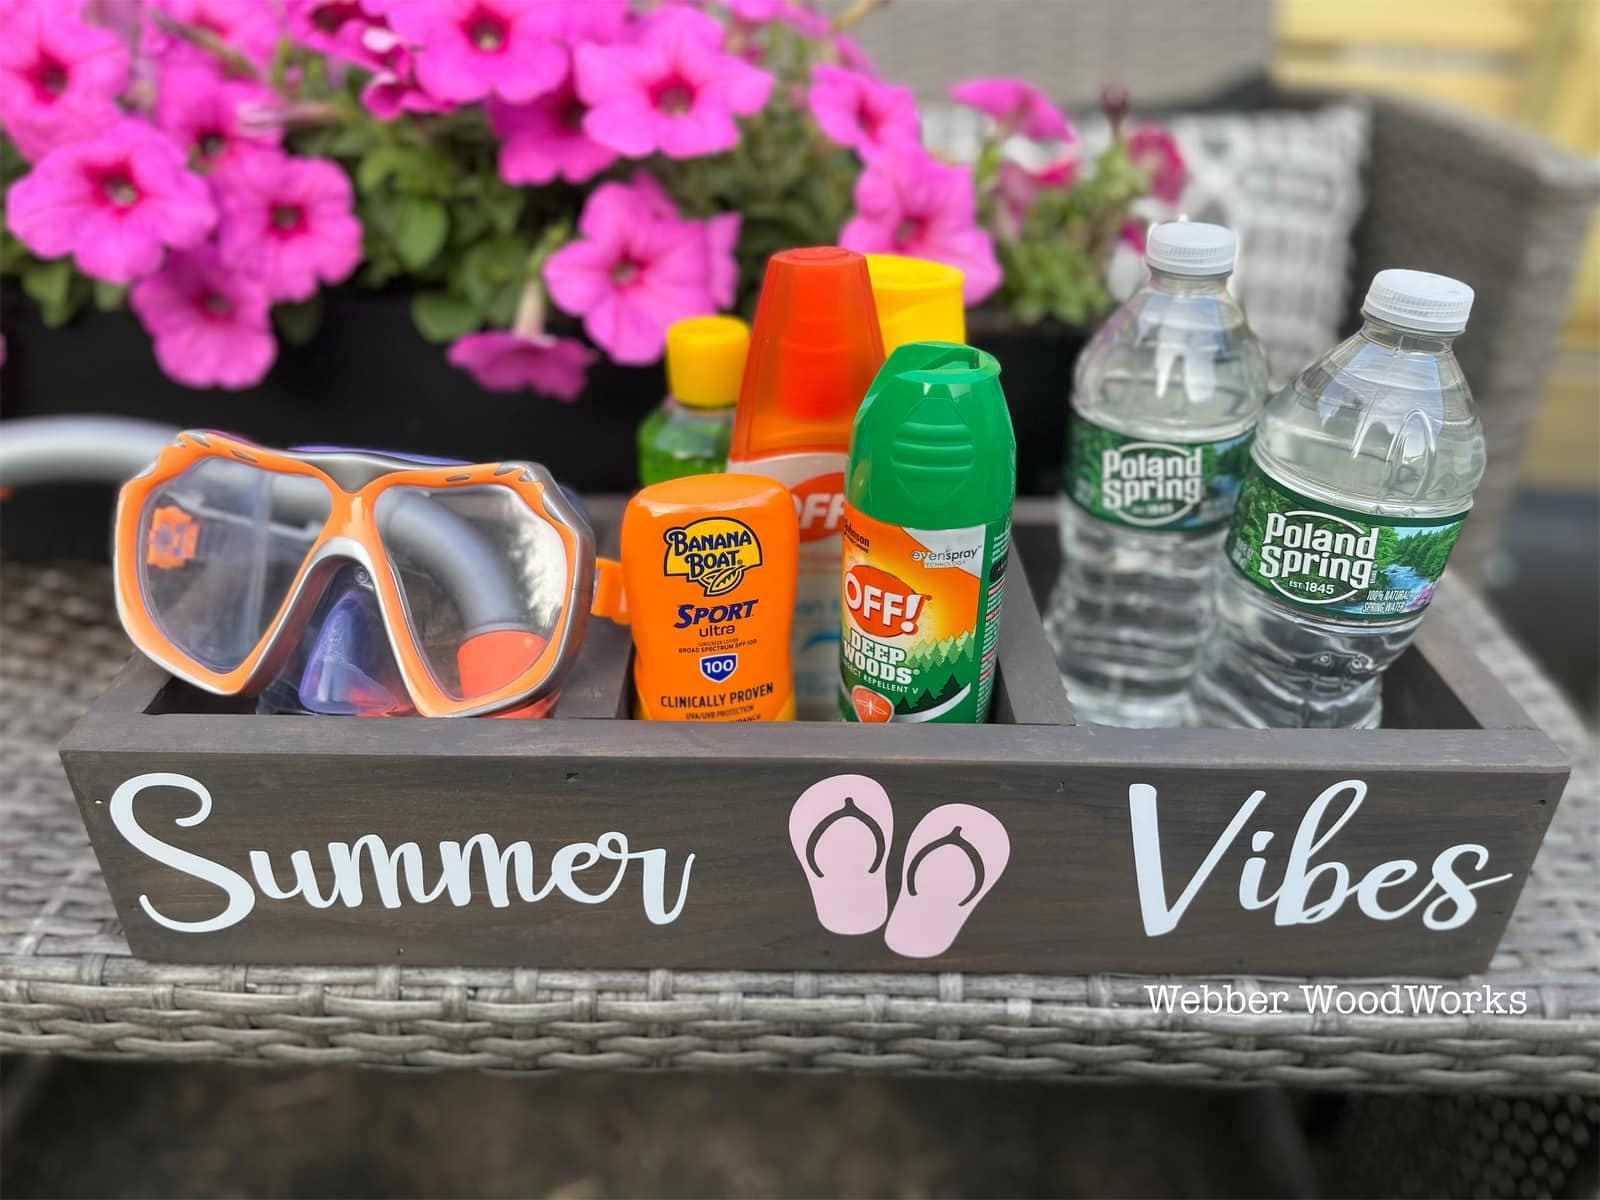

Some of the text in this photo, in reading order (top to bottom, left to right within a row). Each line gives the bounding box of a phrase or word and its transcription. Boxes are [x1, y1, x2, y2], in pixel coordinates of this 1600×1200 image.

[1102, 447, 1203, 479] Poland
[1102, 476, 1202, 510] Spring
[793, 493, 846, 529] FF
[668, 530, 752, 557] BANANA
[1262, 512, 1380, 560] Poland
[684, 549, 740, 578] BOAT
[911, 547, 978, 562] evenspray
[1258, 545, 1377, 589] Spring
[845, 572, 923, 632] OFF!
[1304, 580, 1335, 595] 1845
[1384, 589, 1411, 601] NATURAL
[673, 598, 759, 629] SPORT
[1384, 601, 1406, 613] WATER
[698, 624, 736, 638] ultra
[701, 643, 734, 653] SPECTRUM
[735, 640, 746, 649] SPF
[851, 629, 906, 665] DEEP
[704, 659, 735, 674] 100
[844, 640, 913, 685] WOODS
[660, 681, 774, 708] CLINICALLY PROVEN
[863, 674, 909, 694] REPELLENT
[109, 772, 1513, 937] Summer Vibes
